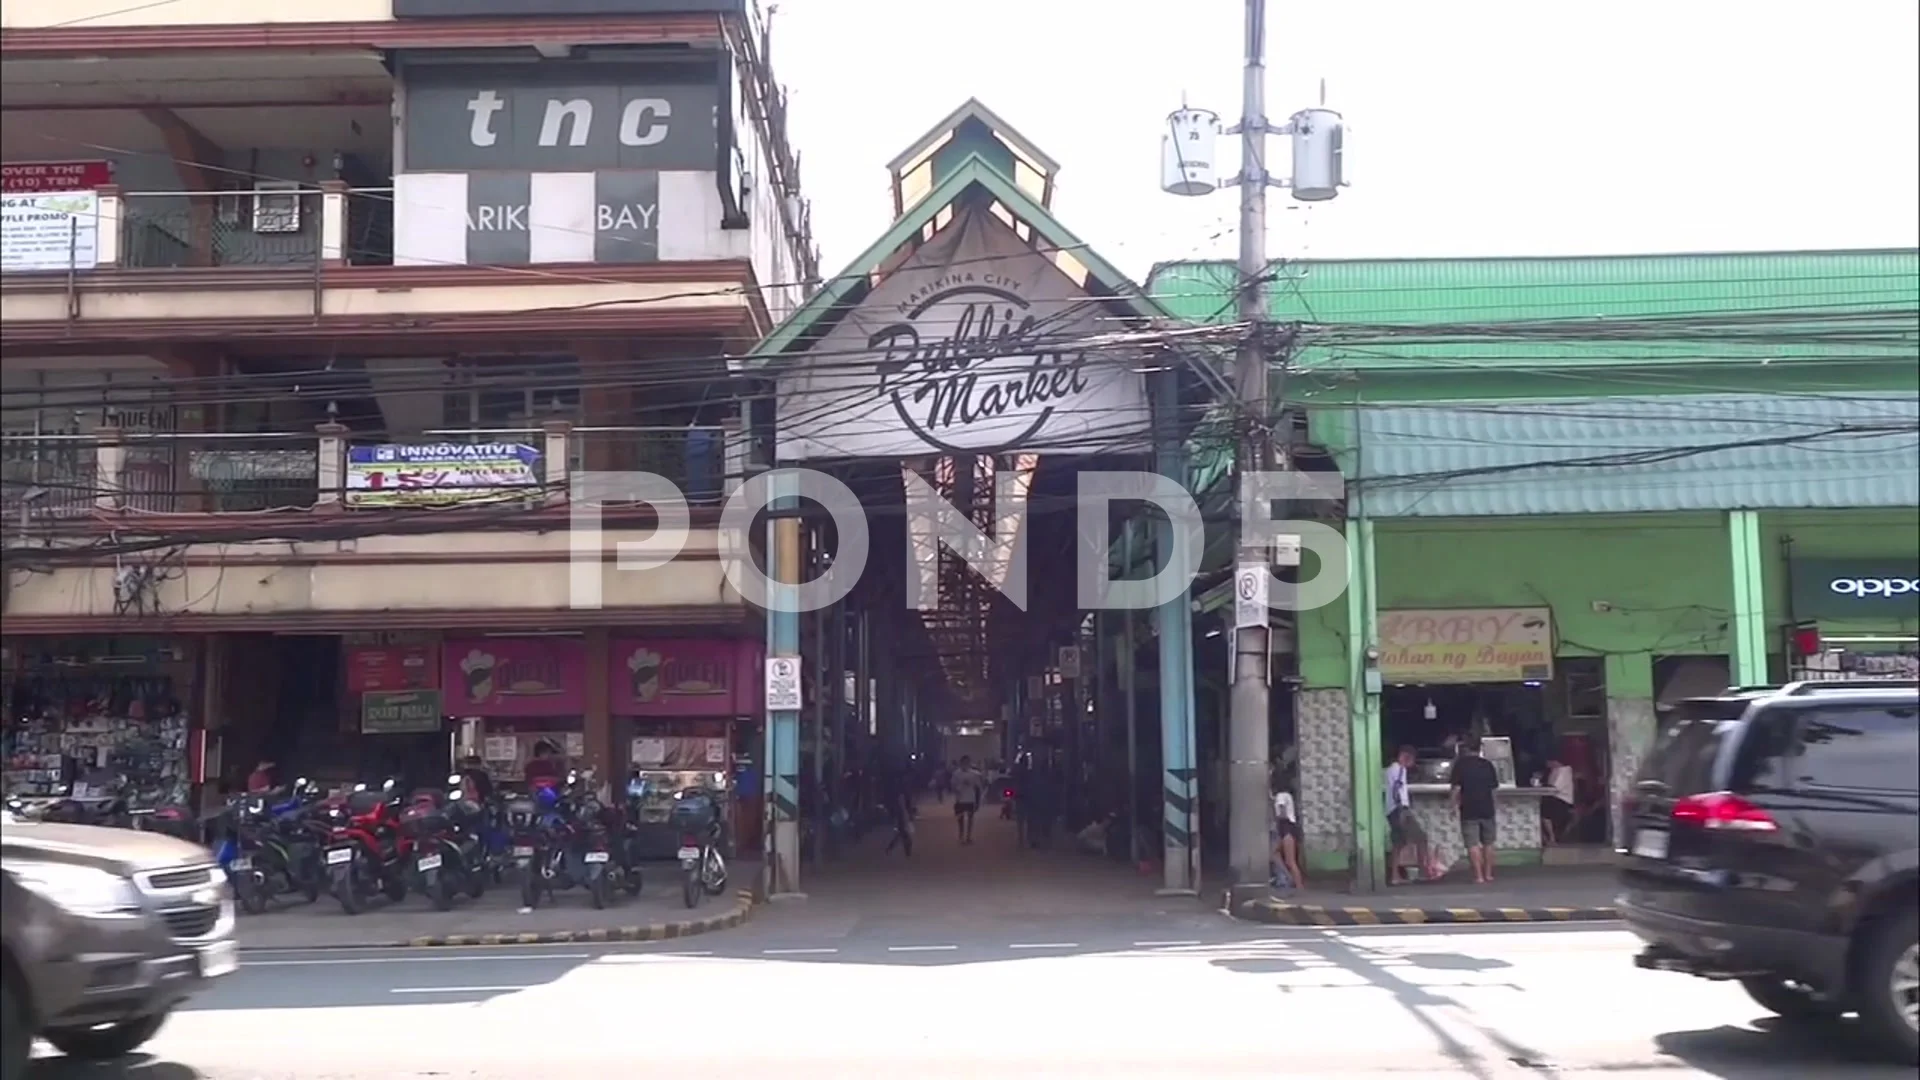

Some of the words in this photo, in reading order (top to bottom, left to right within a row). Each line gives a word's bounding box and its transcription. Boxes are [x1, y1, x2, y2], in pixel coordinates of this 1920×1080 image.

[466, 90, 672, 147] tnc
[2, 165, 47, 176] OVER
[52, 164, 85, 174] THE
[9, 178, 40, 189] (10)
[46, 176, 79, 186] TEN
[19, 198, 36, 207] AT
[27, 212, 69, 222] PROMO
[896, 273, 975, 315] MARIKINA
[983, 272, 1022, 291] CITY
[867, 302, 1036, 397] Public
[914, 350, 1089, 431] Market
[400, 444, 518, 457] INNOVATIVE
[1442, 652, 1467, 670] ng
[1475, 644, 1545, 669] Bayan
